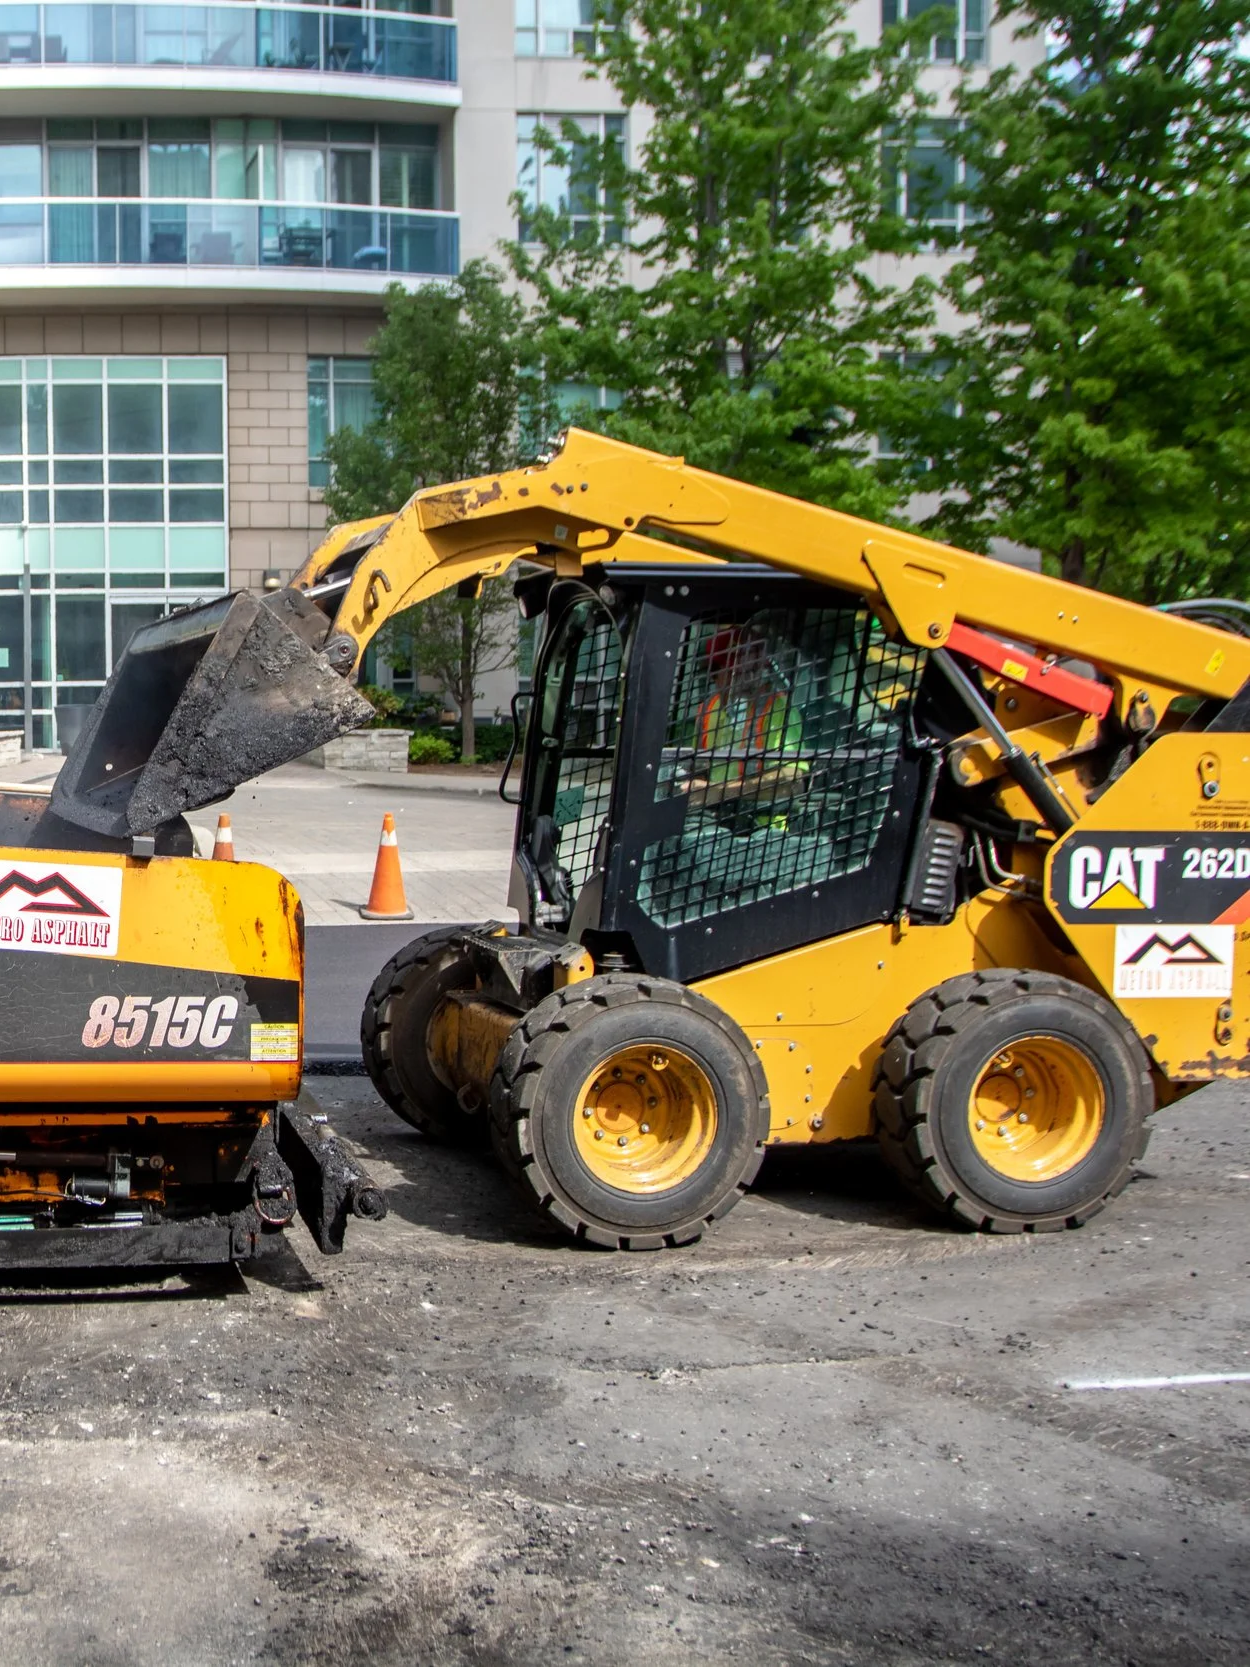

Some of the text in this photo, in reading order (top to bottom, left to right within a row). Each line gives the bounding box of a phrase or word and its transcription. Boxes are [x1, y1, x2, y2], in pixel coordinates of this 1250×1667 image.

[1068, 846, 1165, 909] CAT
[1181, 847, 1250, 879] 262D
[31, 918, 111, 948] ASPHALT
[81, 995, 239, 1048] 8515C
